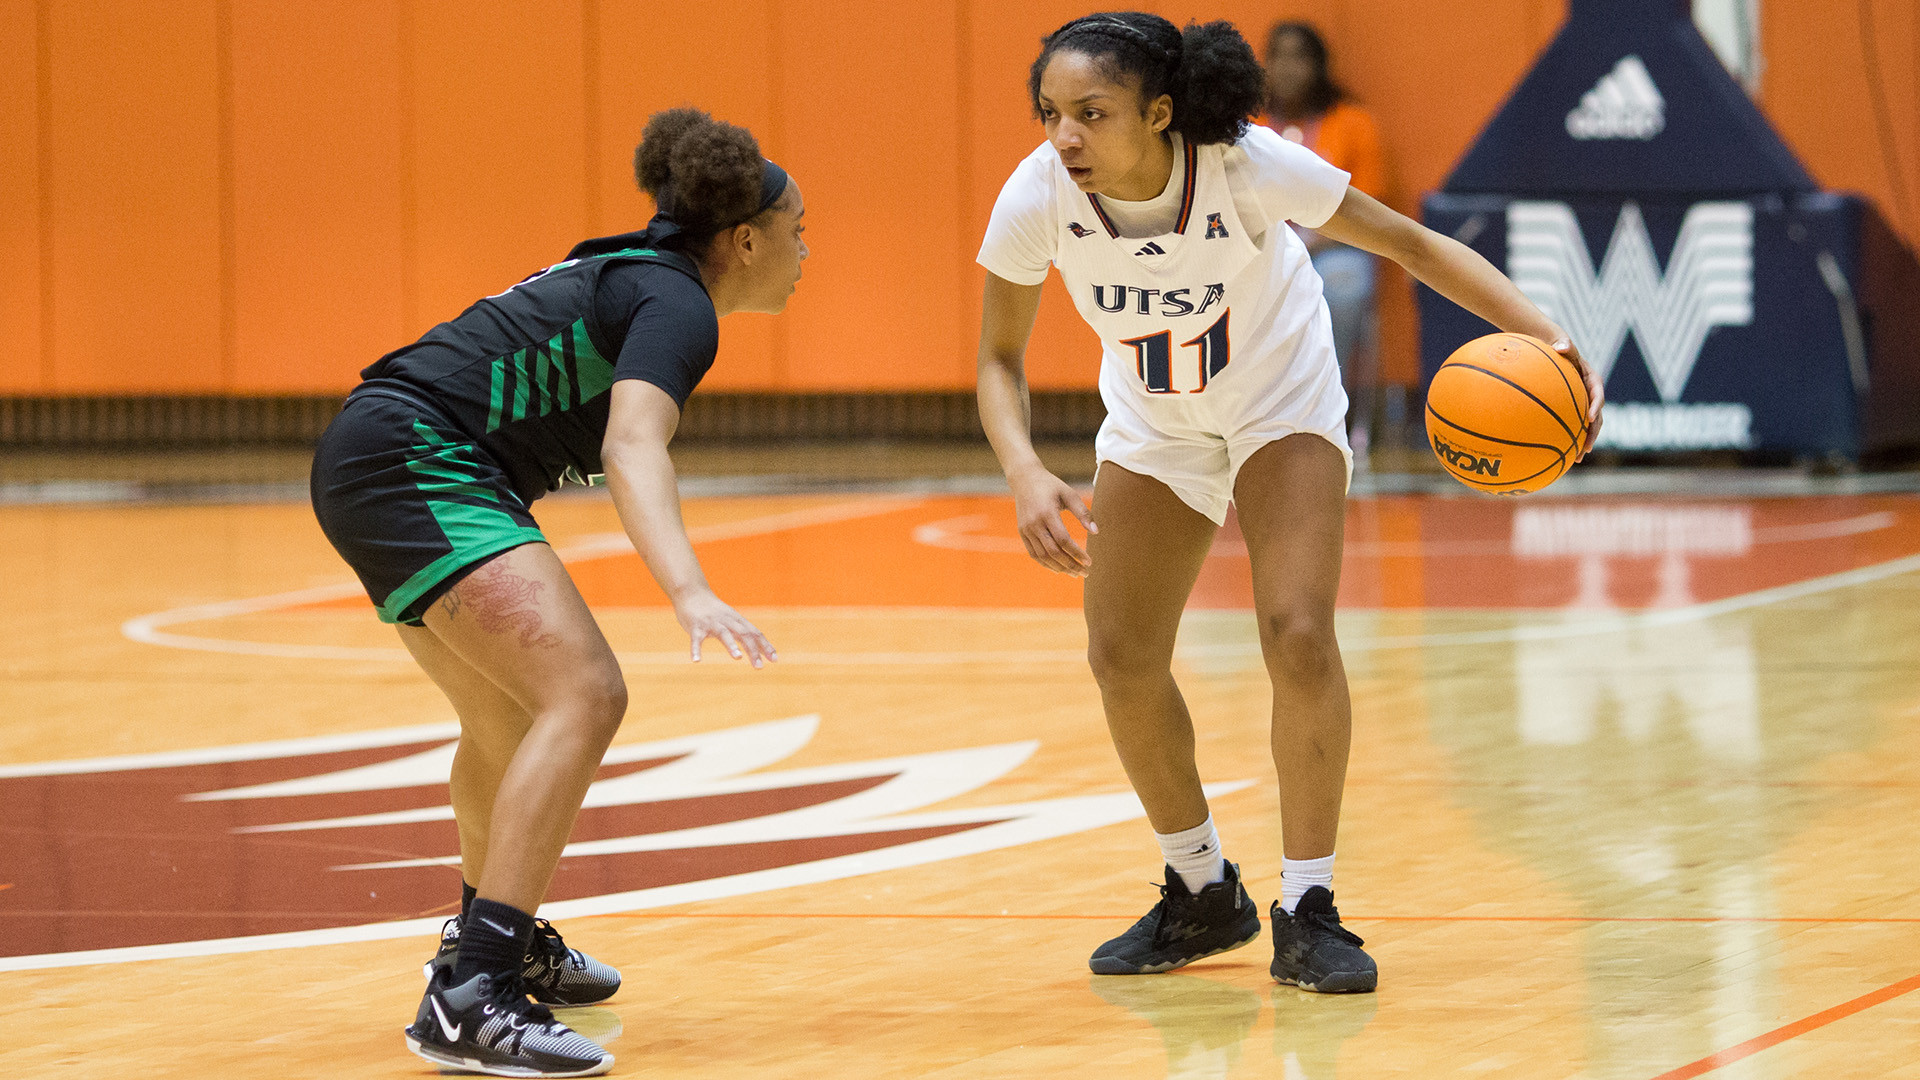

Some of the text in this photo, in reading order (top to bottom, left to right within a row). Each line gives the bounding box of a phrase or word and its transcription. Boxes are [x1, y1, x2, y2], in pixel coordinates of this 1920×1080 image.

[1091, 282, 1225, 317] UTSA
[1119, 306, 1231, 394] 11
[1433, 434, 1501, 476] NCAA
